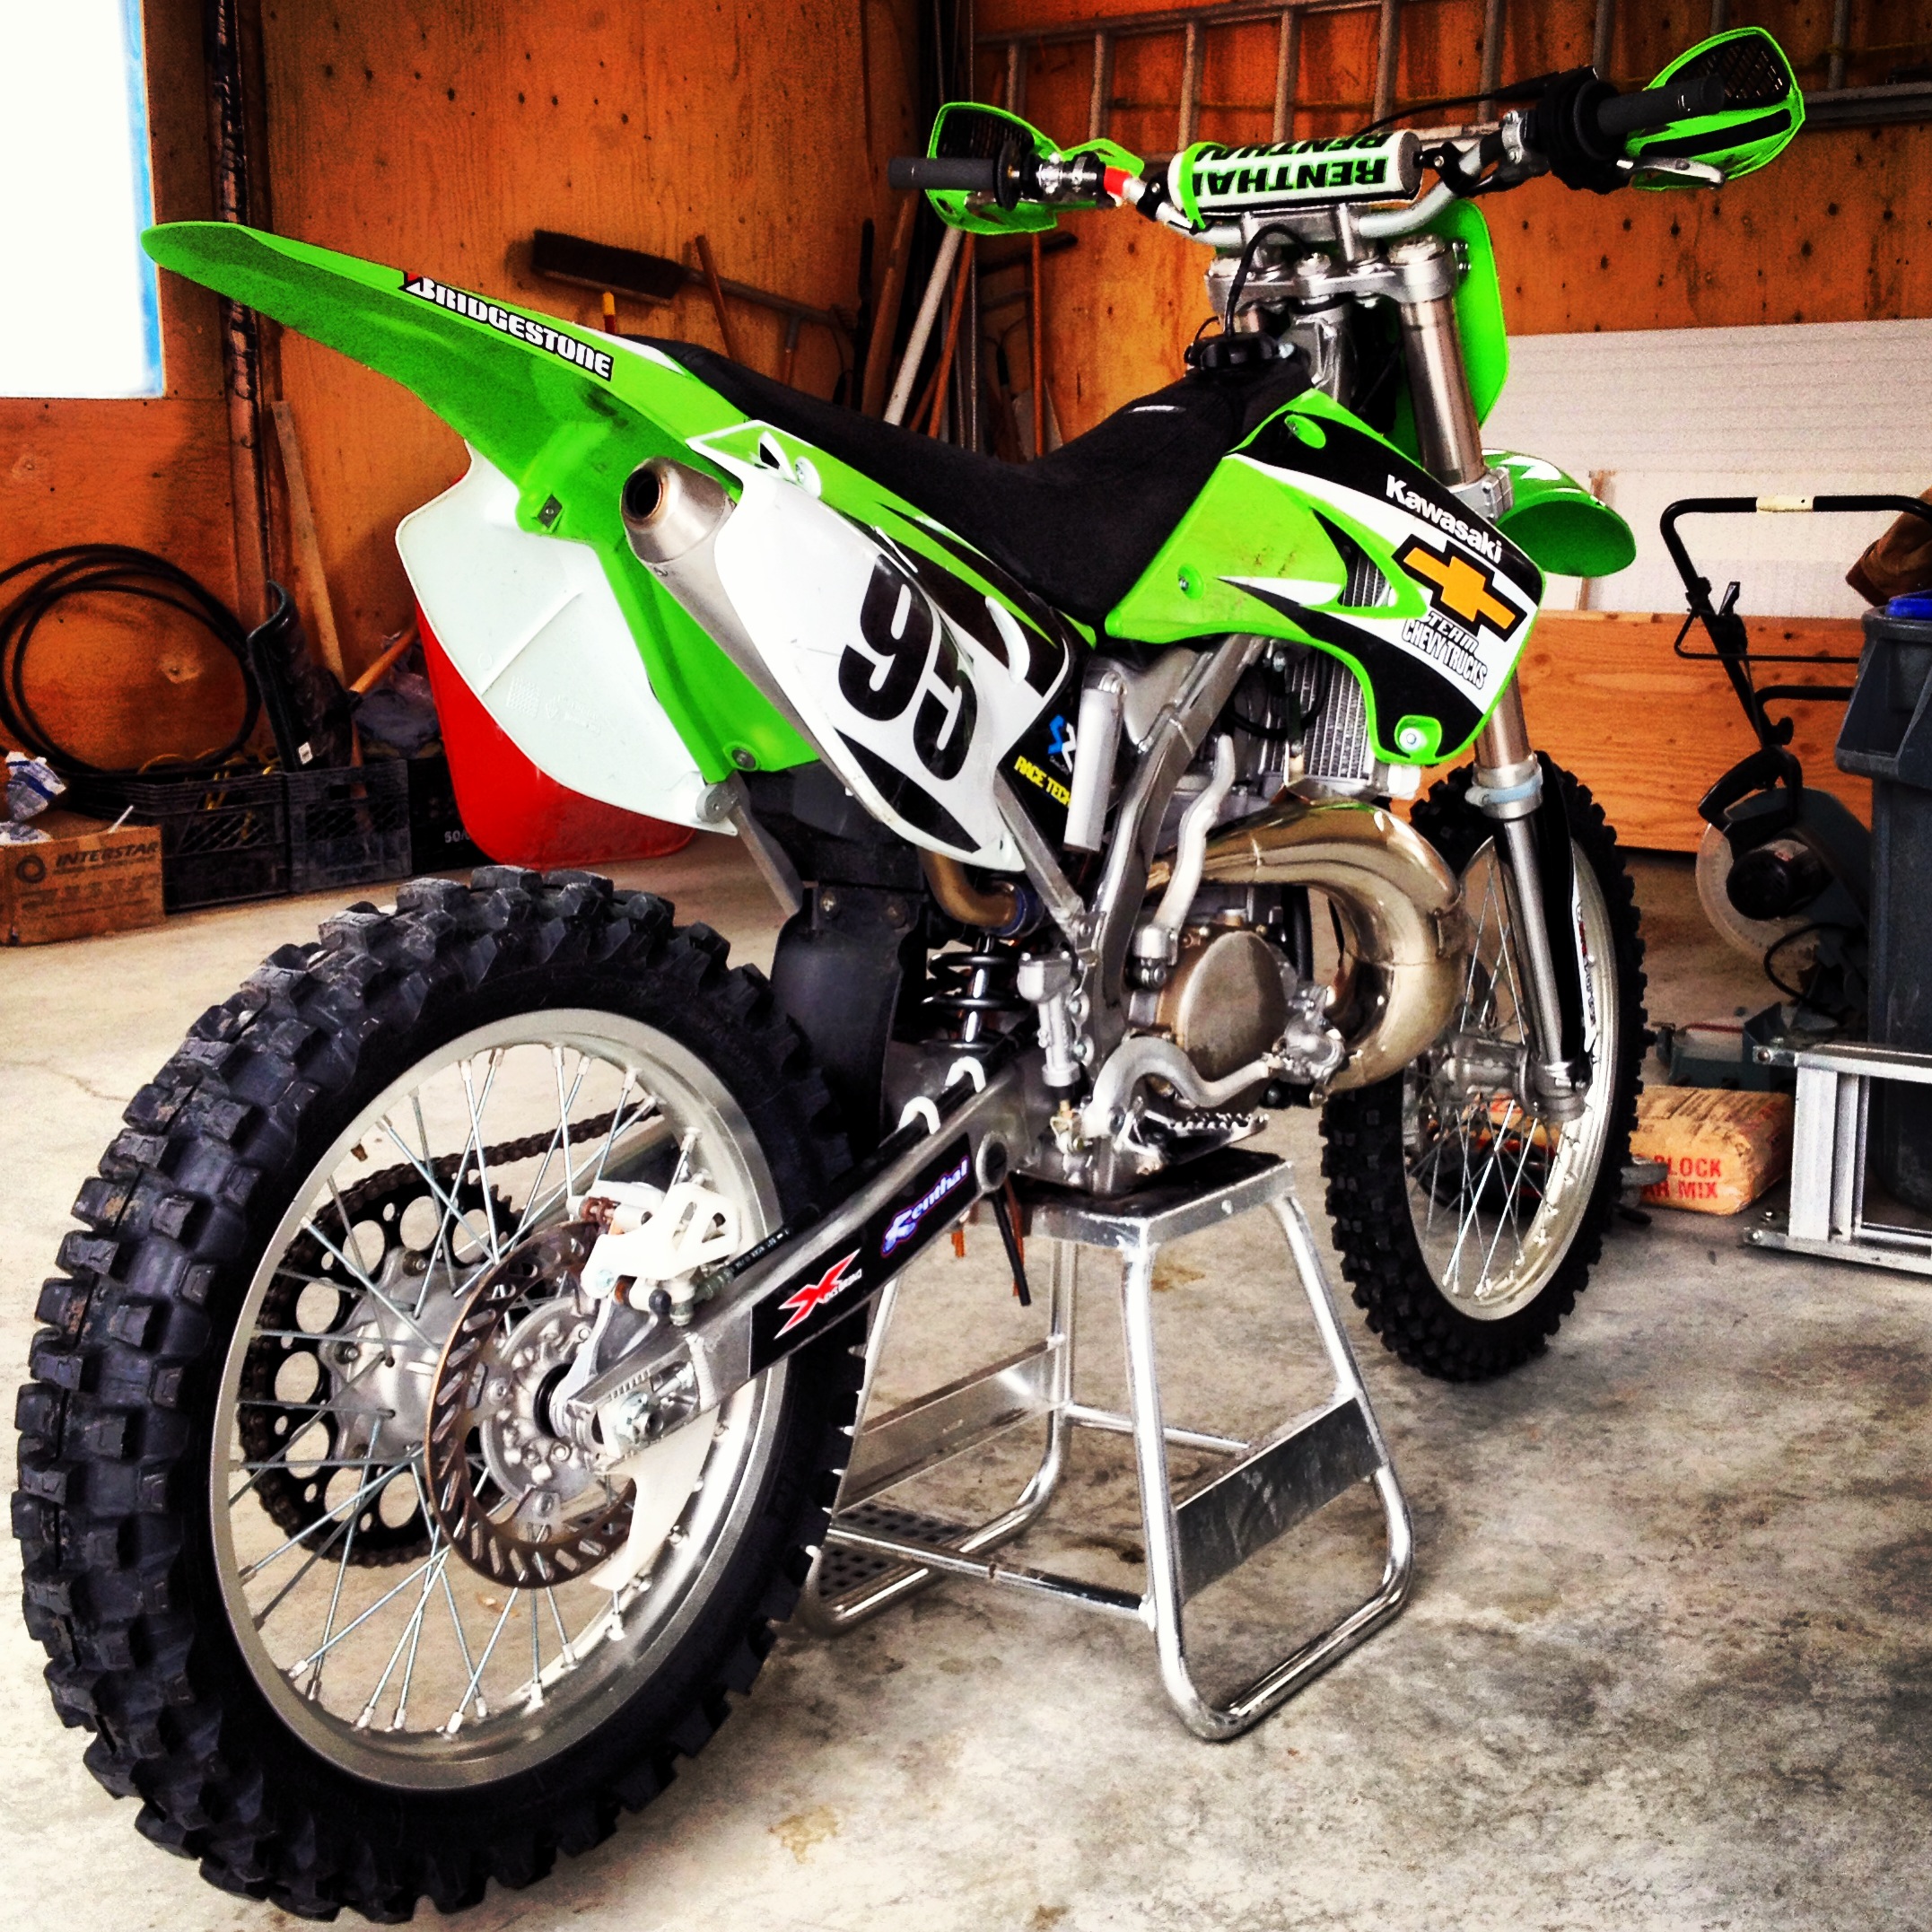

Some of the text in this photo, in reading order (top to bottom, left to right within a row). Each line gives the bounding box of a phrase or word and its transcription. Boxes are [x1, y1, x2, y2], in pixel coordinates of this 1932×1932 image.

[406, 274, 612, 379] BRIDGESTONE
[1386, 474, 1502, 564] Kawasaki
[1402, 618, 1488, 689] CHEVY TRUCKS
[1429, 611, 1479, 652] TEAM
[1014, 756, 1047, 788] RACE
[56, 842, 160, 868] INTERSTAR
[882, 1157, 970, 1254] Renthal
[1678, 1180, 1718, 1201] MIX
